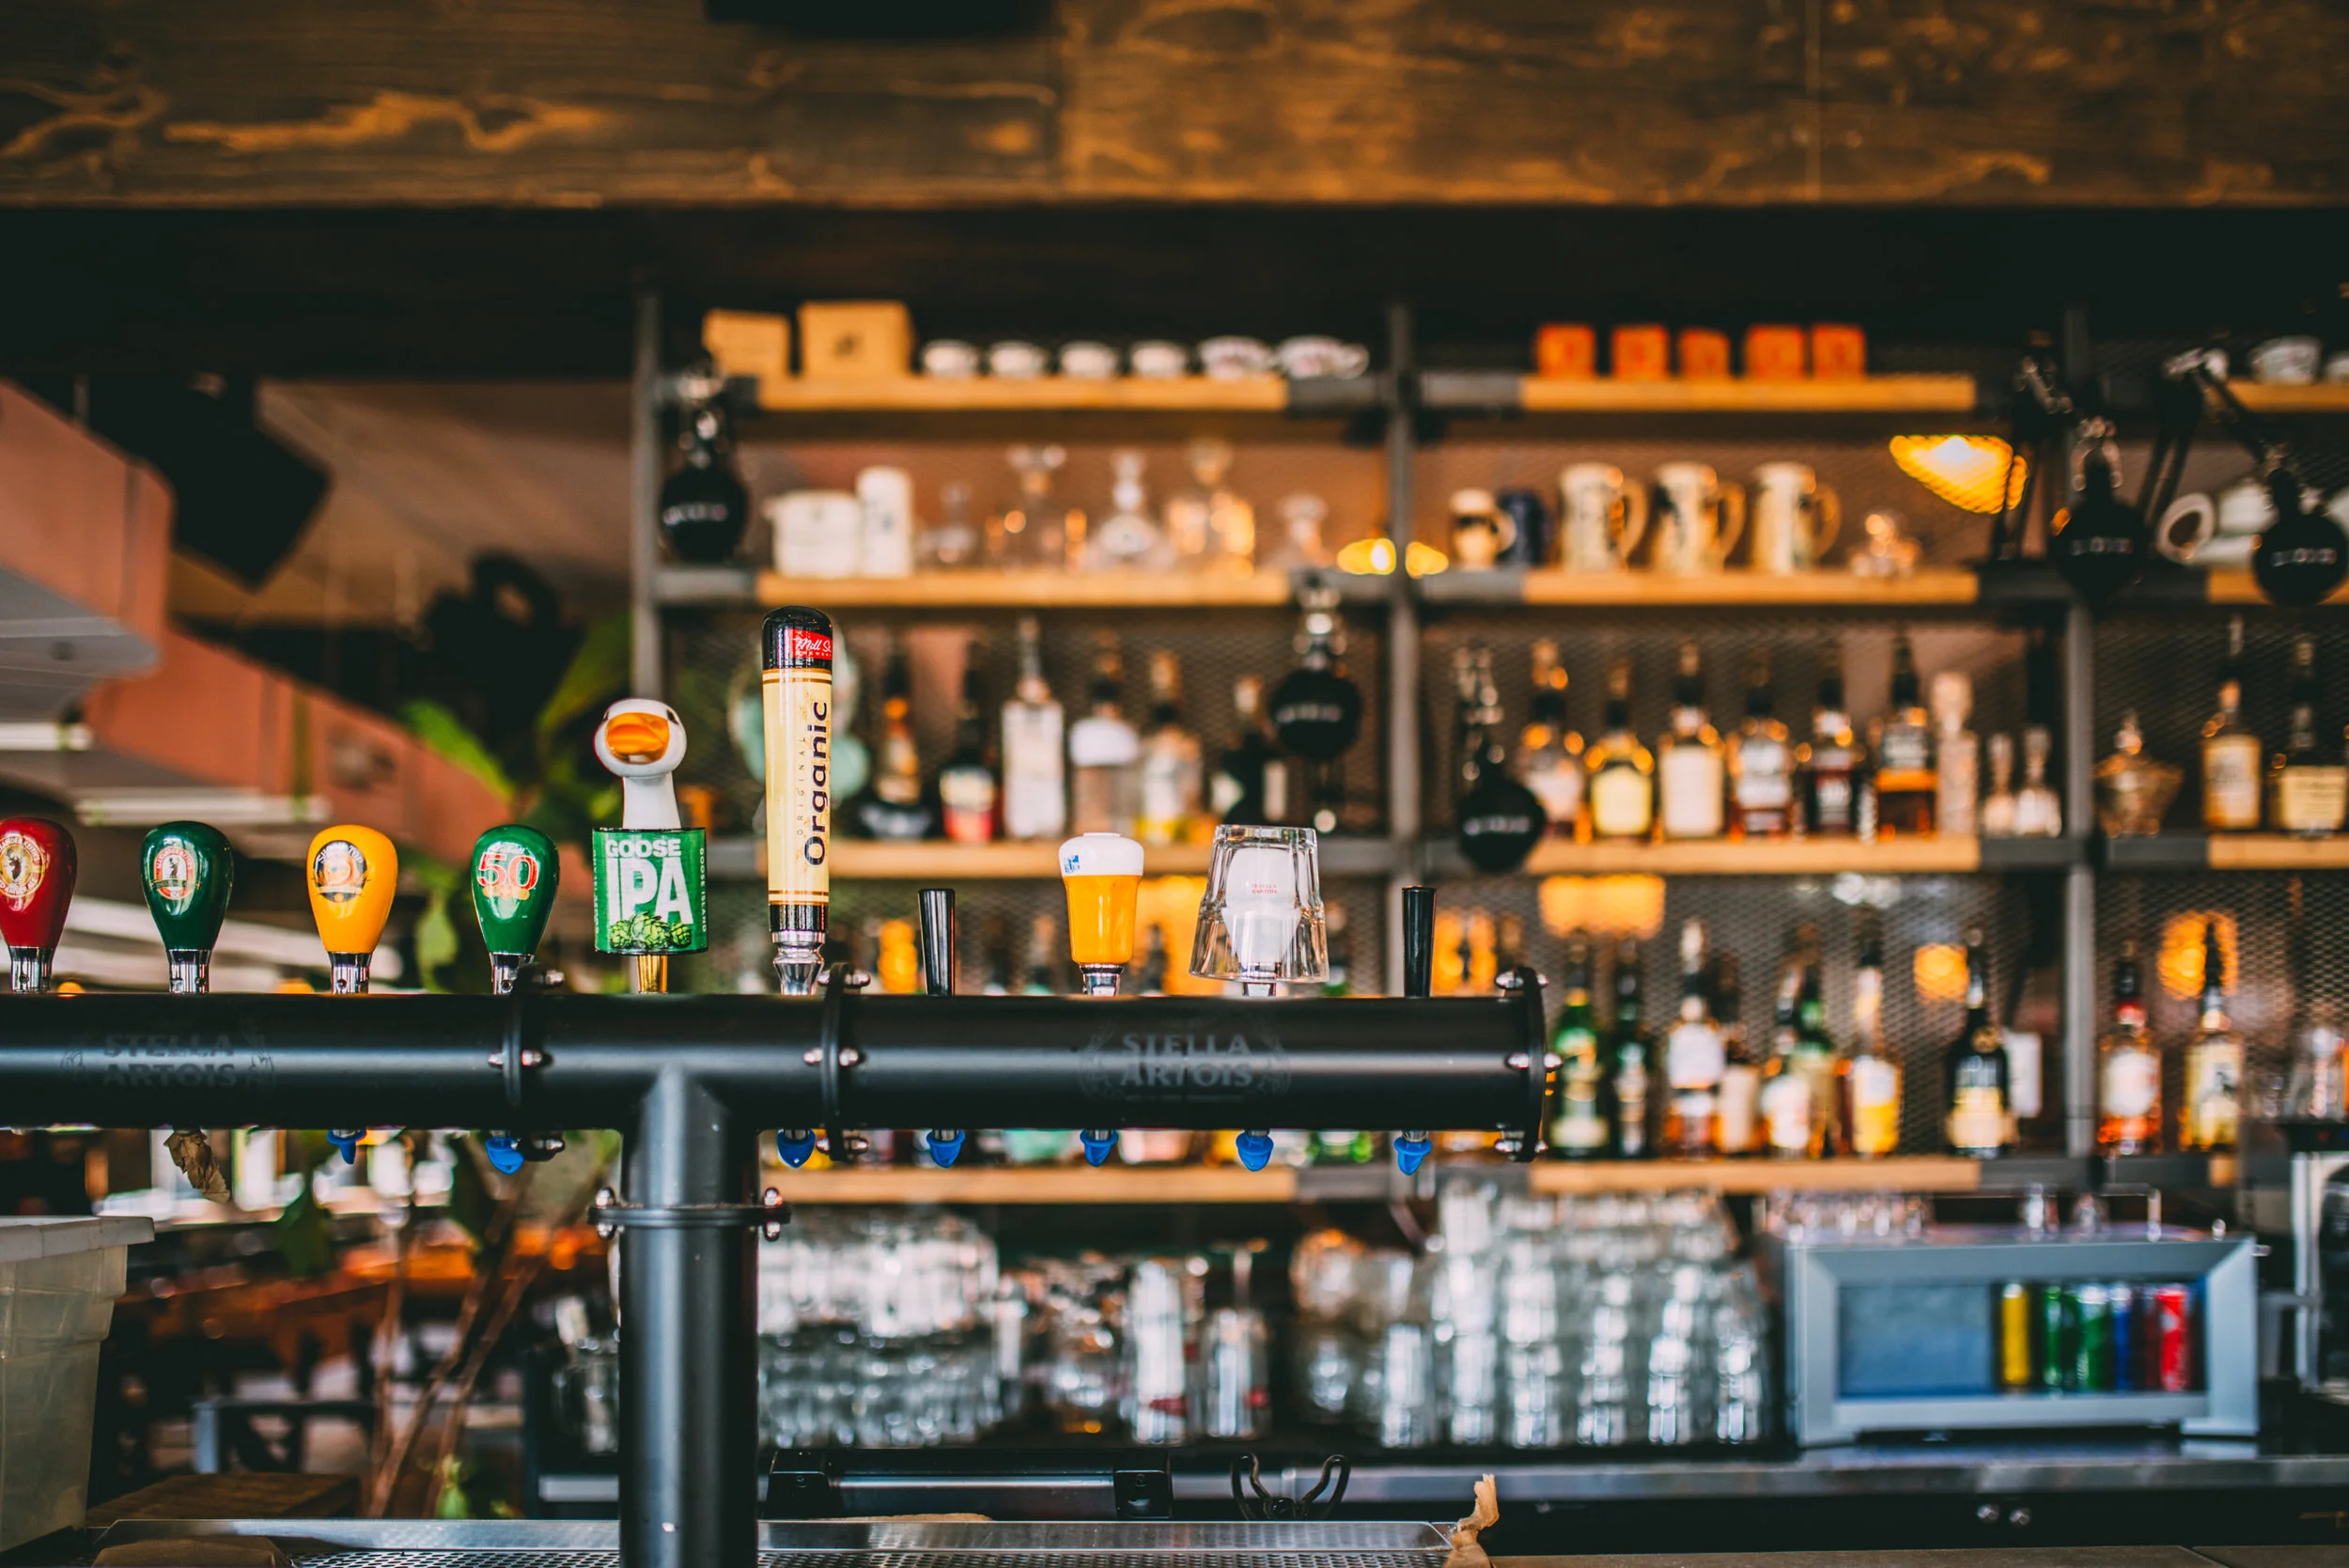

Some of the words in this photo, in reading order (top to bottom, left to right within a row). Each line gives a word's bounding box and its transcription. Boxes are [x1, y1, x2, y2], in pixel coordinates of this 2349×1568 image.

[793, 637, 822, 651] Mill
[797, 737, 806, 835] ORIGINAL
[804, 702, 829, 866] Organic
[349, 845, 364, 863] TOP
[605, 838, 682, 858] GOOSE
[476, 852, 539, 891] 50
[606, 856, 694, 925] IPA
[103, 1034, 235, 1057] STELLA
[1121, 1032, 1252, 1058] STELLA
[101, 1063, 237, 1087] ARTOIS
[1120, 1063, 1253, 1087] ARTOIS
